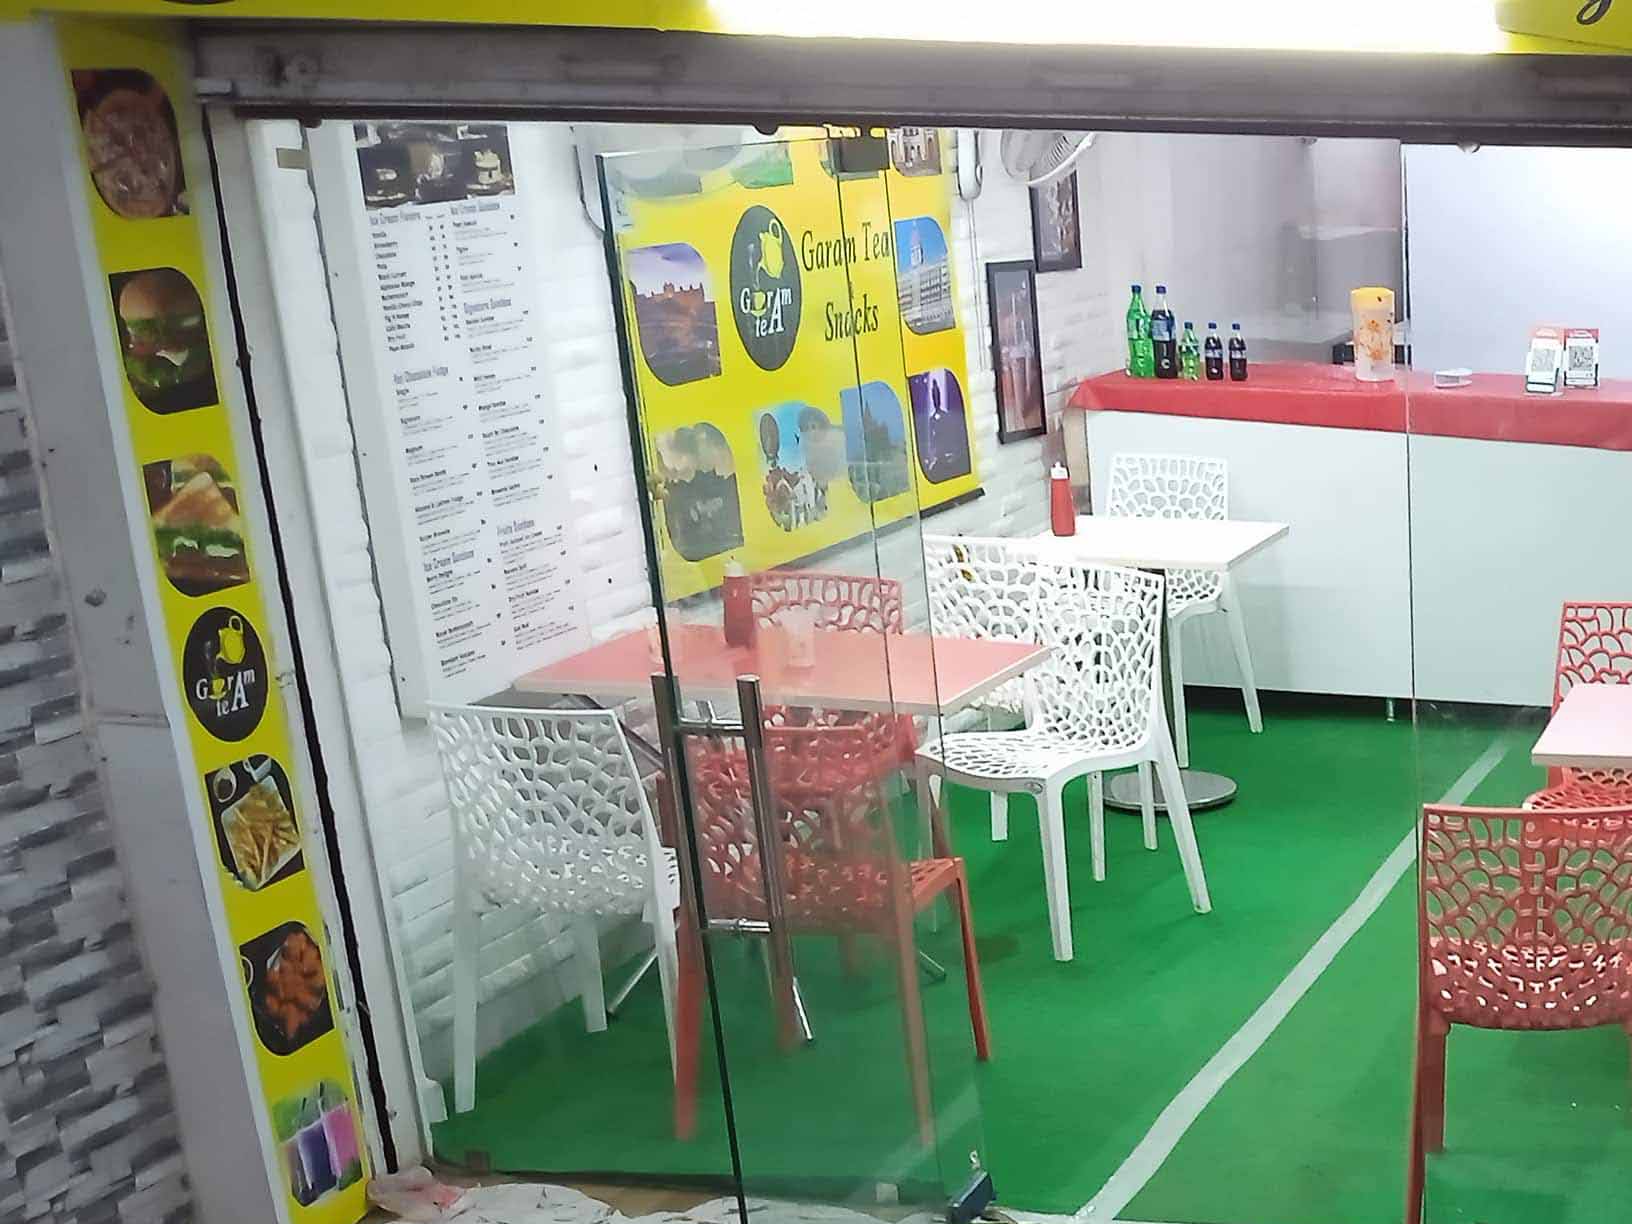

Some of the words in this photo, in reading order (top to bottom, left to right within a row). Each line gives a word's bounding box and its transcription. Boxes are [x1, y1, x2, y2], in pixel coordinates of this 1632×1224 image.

[801, 230, 856, 272] Garam
[862, 221, 890, 261] Tea
[824, 293, 879, 342] Snacks
